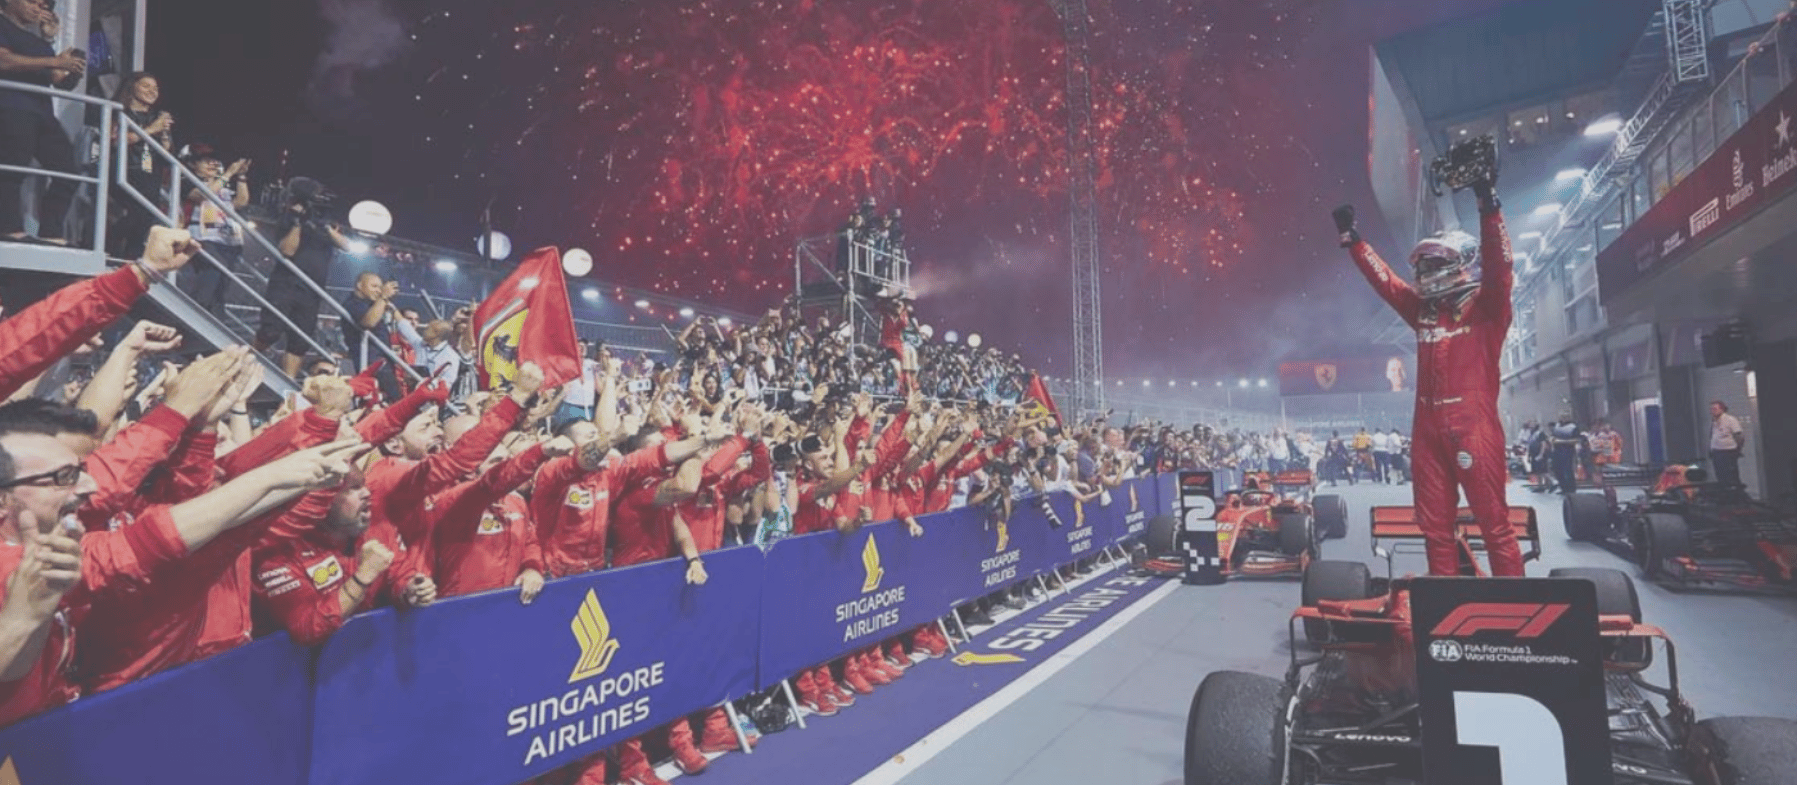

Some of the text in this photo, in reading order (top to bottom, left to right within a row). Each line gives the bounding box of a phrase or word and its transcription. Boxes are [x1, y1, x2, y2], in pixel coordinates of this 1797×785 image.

[1689, 197, 1720, 237] PIRELLI
[1182, 494, 1217, 532] 2
[835, 585, 906, 623] SINGAPORE
[987, 587, 1129, 651] AIRLINES
[1429, 602, 1571, 637] F1
[843, 608, 900, 643] AIRLINES
[1431, 643, 1460, 658] FIA
[1465, 644, 1481, 654] FIA
[1482, 644, 1524, 655] Formula
[1465, 653, 1496, 662] World
[1497, 653, 1570, 665] Championship
[507, 661, 665, 736] SINGAPORE
[524, 696, 650, 765] AIRLINES
[1453, 690, 1567, 785] 1
